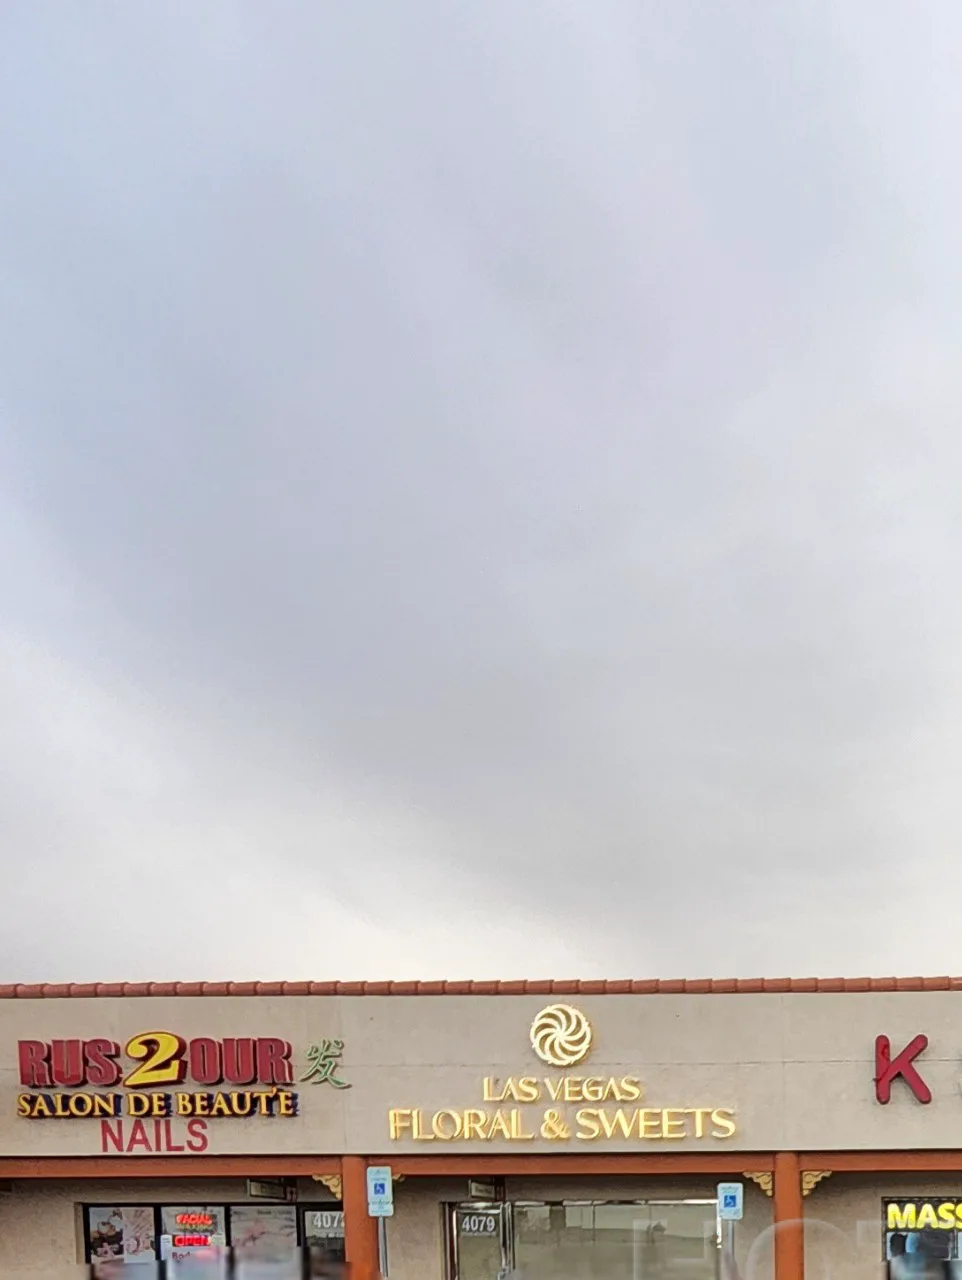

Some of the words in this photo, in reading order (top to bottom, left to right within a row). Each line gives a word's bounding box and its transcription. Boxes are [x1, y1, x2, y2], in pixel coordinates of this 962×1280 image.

[873, 1034, 932, 1104] K
[483, 1076, 540, 1102] LAS
[543, 1075, 642, 1102] VEGAS
[17, 1092, 117, 1118] SALON
[127, 1092, 168, 1116] DE
[100, 1119, 209, 1152] NAILS
[388, 1108, 534, 1141] FLORAL
[540, 1107, 570, 1140] &
[575, 1107, 739, 1140] SWEETS
[462, 1215, 496, 1232] 4079
